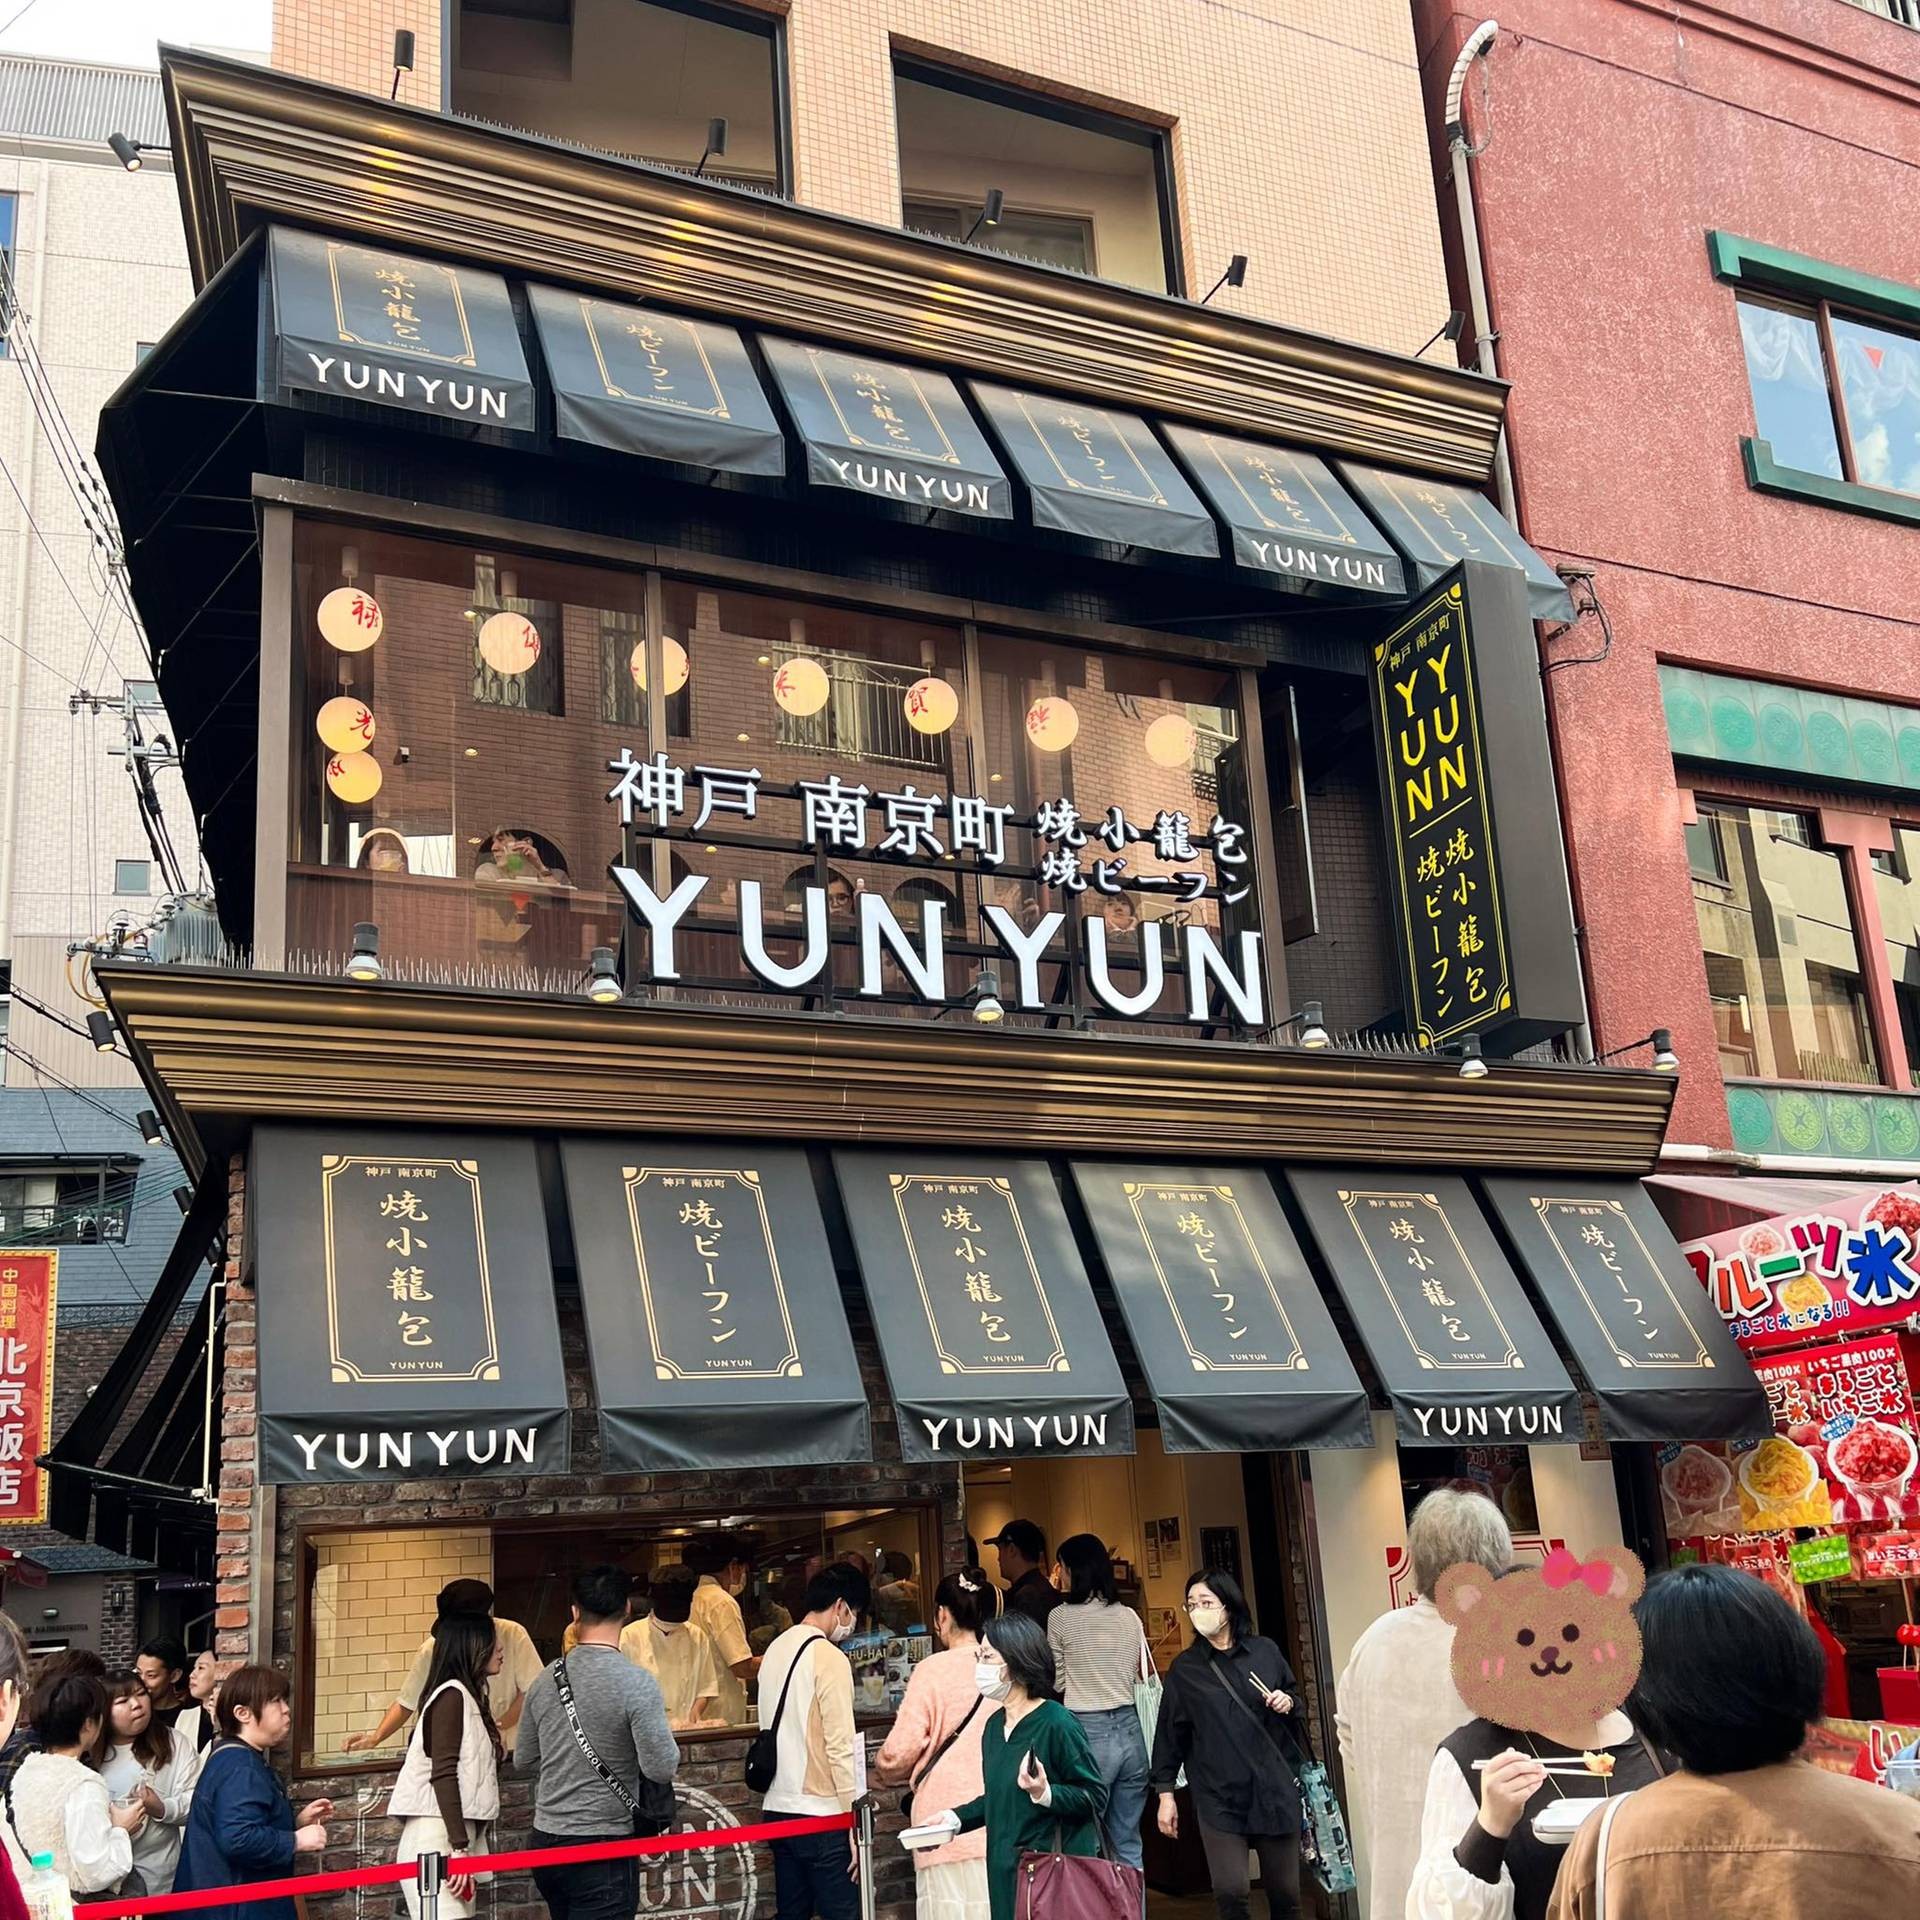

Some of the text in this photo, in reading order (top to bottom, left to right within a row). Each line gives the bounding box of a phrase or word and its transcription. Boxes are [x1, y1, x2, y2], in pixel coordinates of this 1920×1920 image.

[626, 324, 674, 390] 焼ビーフン
[607, 748, 1015, 866] 神戸 南京町
[1036, 797, 1248, 864] 焼小籠包
[1041, 847, 1250, 904] 焼ビーフン
[1416, 846, 1454, 1018] 焼ビーフン
[1445, 827, 1488, 1003] 焼小籠包
[364, 1166, 438, 1179] 神戸 南京町
[380, 1190, 434, 1346] 焼小籠包
[678, 1199, 737, 1344] 焼ビーフン
[941, 1204, 1011, 1342] 焼小籠包
[1176, 1211, 1248, 1339] 焼ビーフン
[1389, 1218, 1471, 1341] 焼小籠包
[1581, 1223, 1658, 1340] 焼ビーフン
[574, 1728, 602, 1770] KANGOL
[605, 1775, 638, 1811] KANGOL
